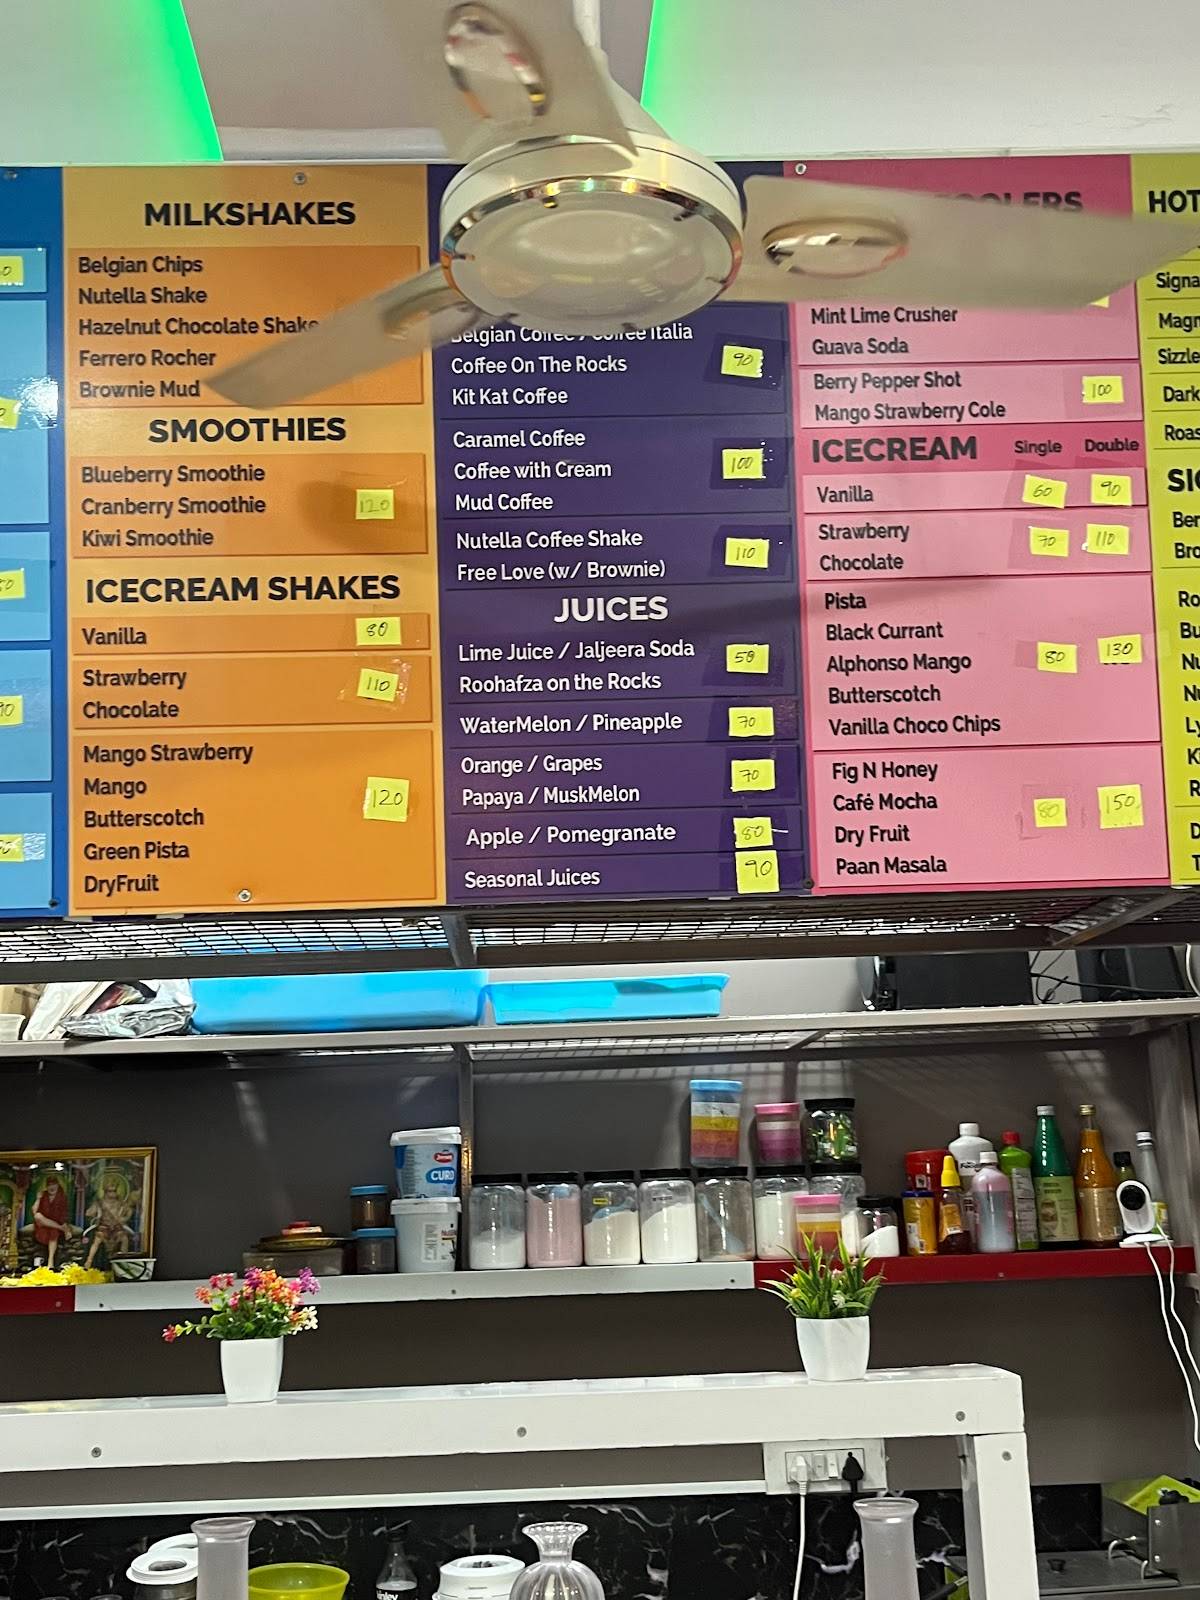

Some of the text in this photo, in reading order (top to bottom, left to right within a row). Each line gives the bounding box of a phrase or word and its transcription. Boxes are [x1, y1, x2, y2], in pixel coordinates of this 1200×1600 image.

[1149, 190, 1200, 213] HOT
[145, 202, 356, 226] MILKSHAKES
[79, 256, 203, 277] Belgian Chips
[1156, 272, 1200, 292] Signa
[79, 287, 207, 304] Nutella Shake
[811, 307, 958, 324] Mint Lime Crusher
[1159, 313, 1200, 332] Magn
[80, 318, 161, 335] Hazelnut
[166, 318, 259, 334] Chocolate
[651, 324, 693, 340] Italia
[451, 327, 515, 346] elgian
[812, 337, 909, 355] Guava Soda
[80, 349, 216, 366] Ferrero Rocher
[452, 355, 627, 373] Coffee On The Rocks
[733, 353, 753, 366] 90
[1158, 348, 1200, 364] Sizzle
[80, 380, 200, 397] Brownie Mud
[814, 371, 961, 393] Berry Pepper Shot
[1091, 383, 1112, 397] 100
[453, 387, 567, 405] Kit Kat Coffee
[1164, 386, 1200, 402] Dark
[815, 401, 1005, 424] Mango Strawberry Cole
[149, 417, 346, 442] SMOOTHIES
[454, 429, 585, 447] Caramel Coffee
[813, 436, 1139, 463] ICECREAM Single Double
[454, 461, 611, 479] Coffee with Cream
[732, 457, 753, 472] 100
[82, 464, 265, 487] Blueberry Smoothie
[1168, 469, 1200, 492] SI
[817, 485, 873, 503] Vanilla
[1033, 485, 1052, 497] 60
[1101, 481, 1120, 496] 90
[82, 496, 266, 519] Cranberry Smoothie
[360, 499, 389, 513] 120
[456, 493, 553, 510] Mud Coffee
[83, 528, 214, 547] Kiwi Smoothie
[457, 529, 643, 549] Nutella Coffee Shake
[819, 522, 909, 542] Strawberry
[1038, 536, 1056, 546] 70
[1096, 531, 1115, 545] 110
[736, 548, 755, 560] 110
[820, 553, 904, 571] Chocolate
[458, 560, 665, 580] Free Love (w/ Brownie)
[87, 575, 400, 603] ICECREAM SHAKES
[554, 596, 668, 622] JUICES
[825, 592, 867, 609] Pista
[82, 627, 146, 645] Vanilla
[827, 622, 944, 640] Black Currant
[459, 639, 695, 662] Lime Juice / Jaljeera Soda
[1046, 651, 1064, 663] 80
[1105, 642, 1133, 656] 130
[827, 654, 971, 676] Alphonso Mango
[83, 669, 187, 689] Strawberry
[367, 677, 390, 691] 110
[460, 672, 661, 692] Roohafza on the Rocks
[829, 684, 940, 704] Butterscotch
[83, 701, 179, 719] Chocolate
[460, 712, 682, 734] WaterMelon / Pineapple
[737, 716, 755, 728] 70
[829, 715, 1000, 736] Vanilla Choco Chips
[84, 743, 253, 767] Mango Strawberry
[461, 755, 602, 777] Orange / Grapes
[833, 762, 938, 784] Fig N Honey
[739, 770, 759, 782] 70
[84, 778, 147, 799] Mango
[463, 785, 639, 809] Papaya / MuskMelon
[373, 790, 403, 808] 120
[833, 792, 937, 811] Café Mocha
[1105, 795, 1136, 814] 150
[85, 808, 204, 827] Butterscotch
[466, 824, 676, 849] Apple / Pomegranate
[835, 824, 910, 847] Dry Fruit
[84, 841, 189, 860] Green Pista
[745, 860, 772, 877] 90
[837, 856, 947, 875] Paan Masala
[85, 874, 159, 897] DryFruit
[465, 868, 600, 888] Seasonal Juices
